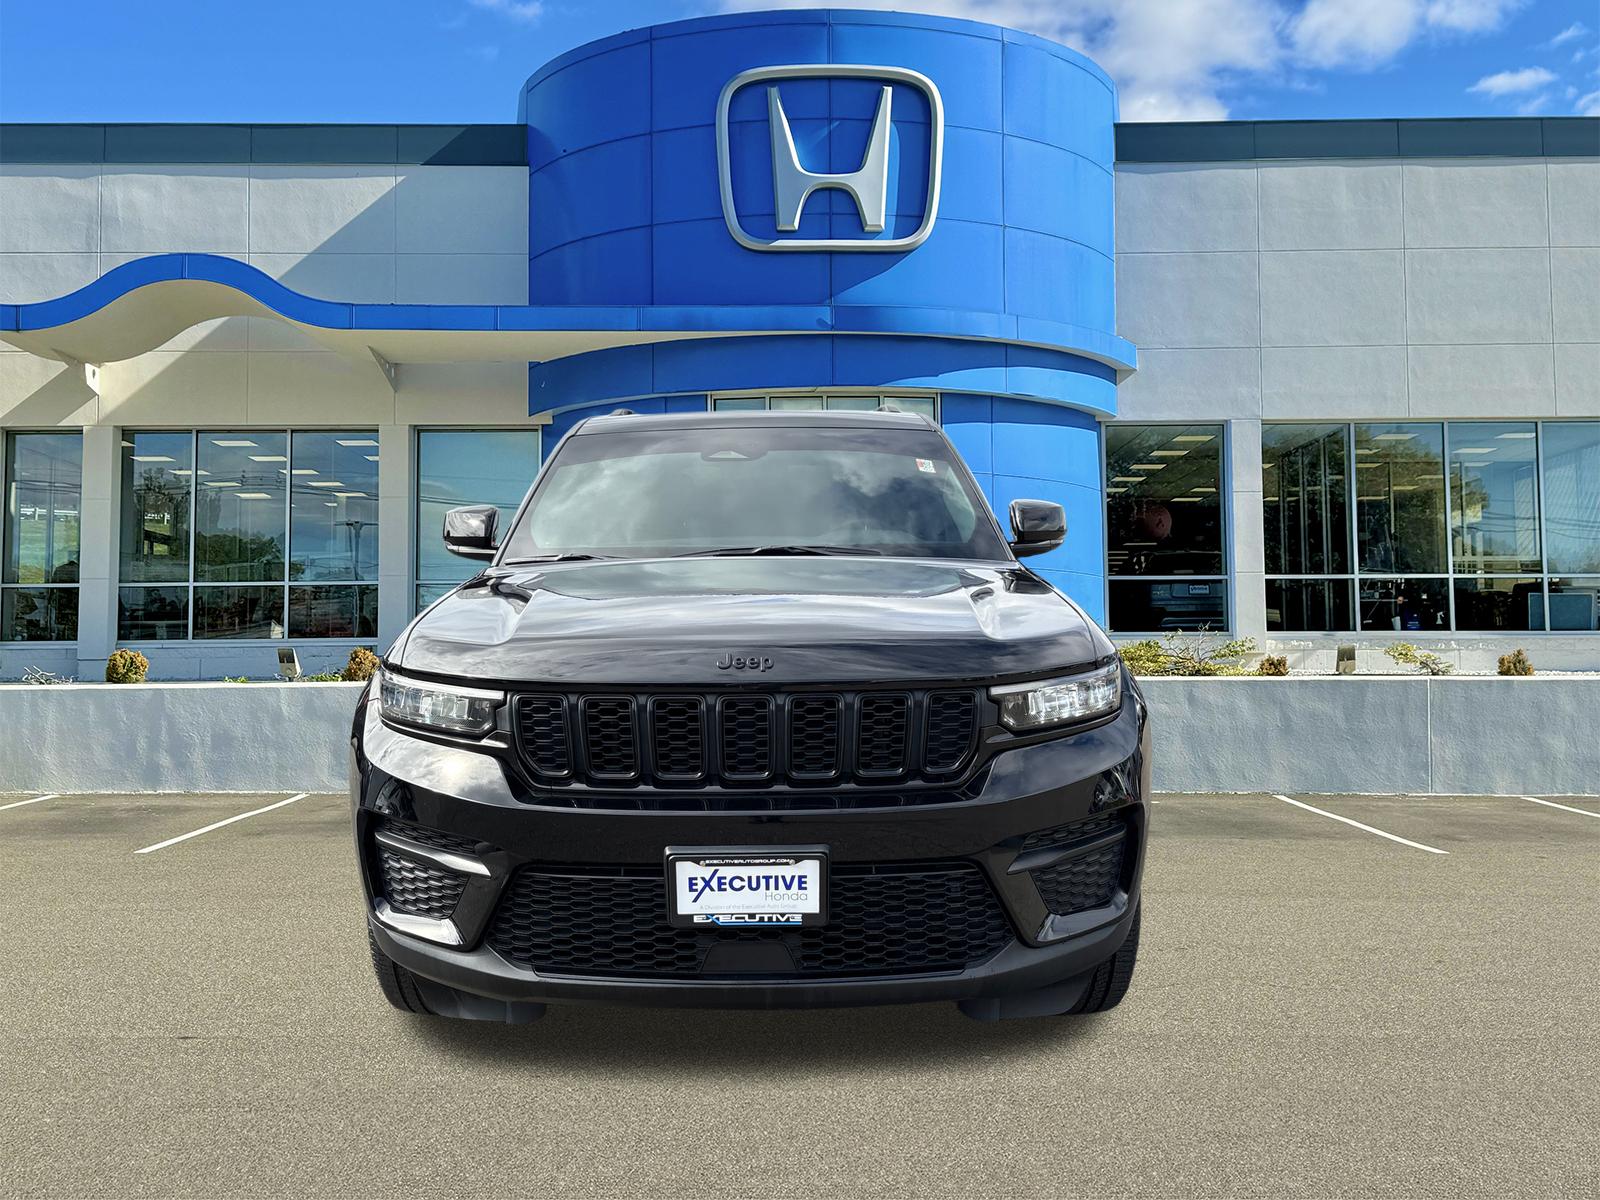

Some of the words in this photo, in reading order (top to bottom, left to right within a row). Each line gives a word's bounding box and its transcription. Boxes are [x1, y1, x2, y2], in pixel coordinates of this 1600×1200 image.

[717, 653, 775, 673] Jeep
[688, 869, 808, 903] EXECUTIVE
[764, 891, 808, 901] Honda
[693, 914, 802, 924] EXECUTIVE
